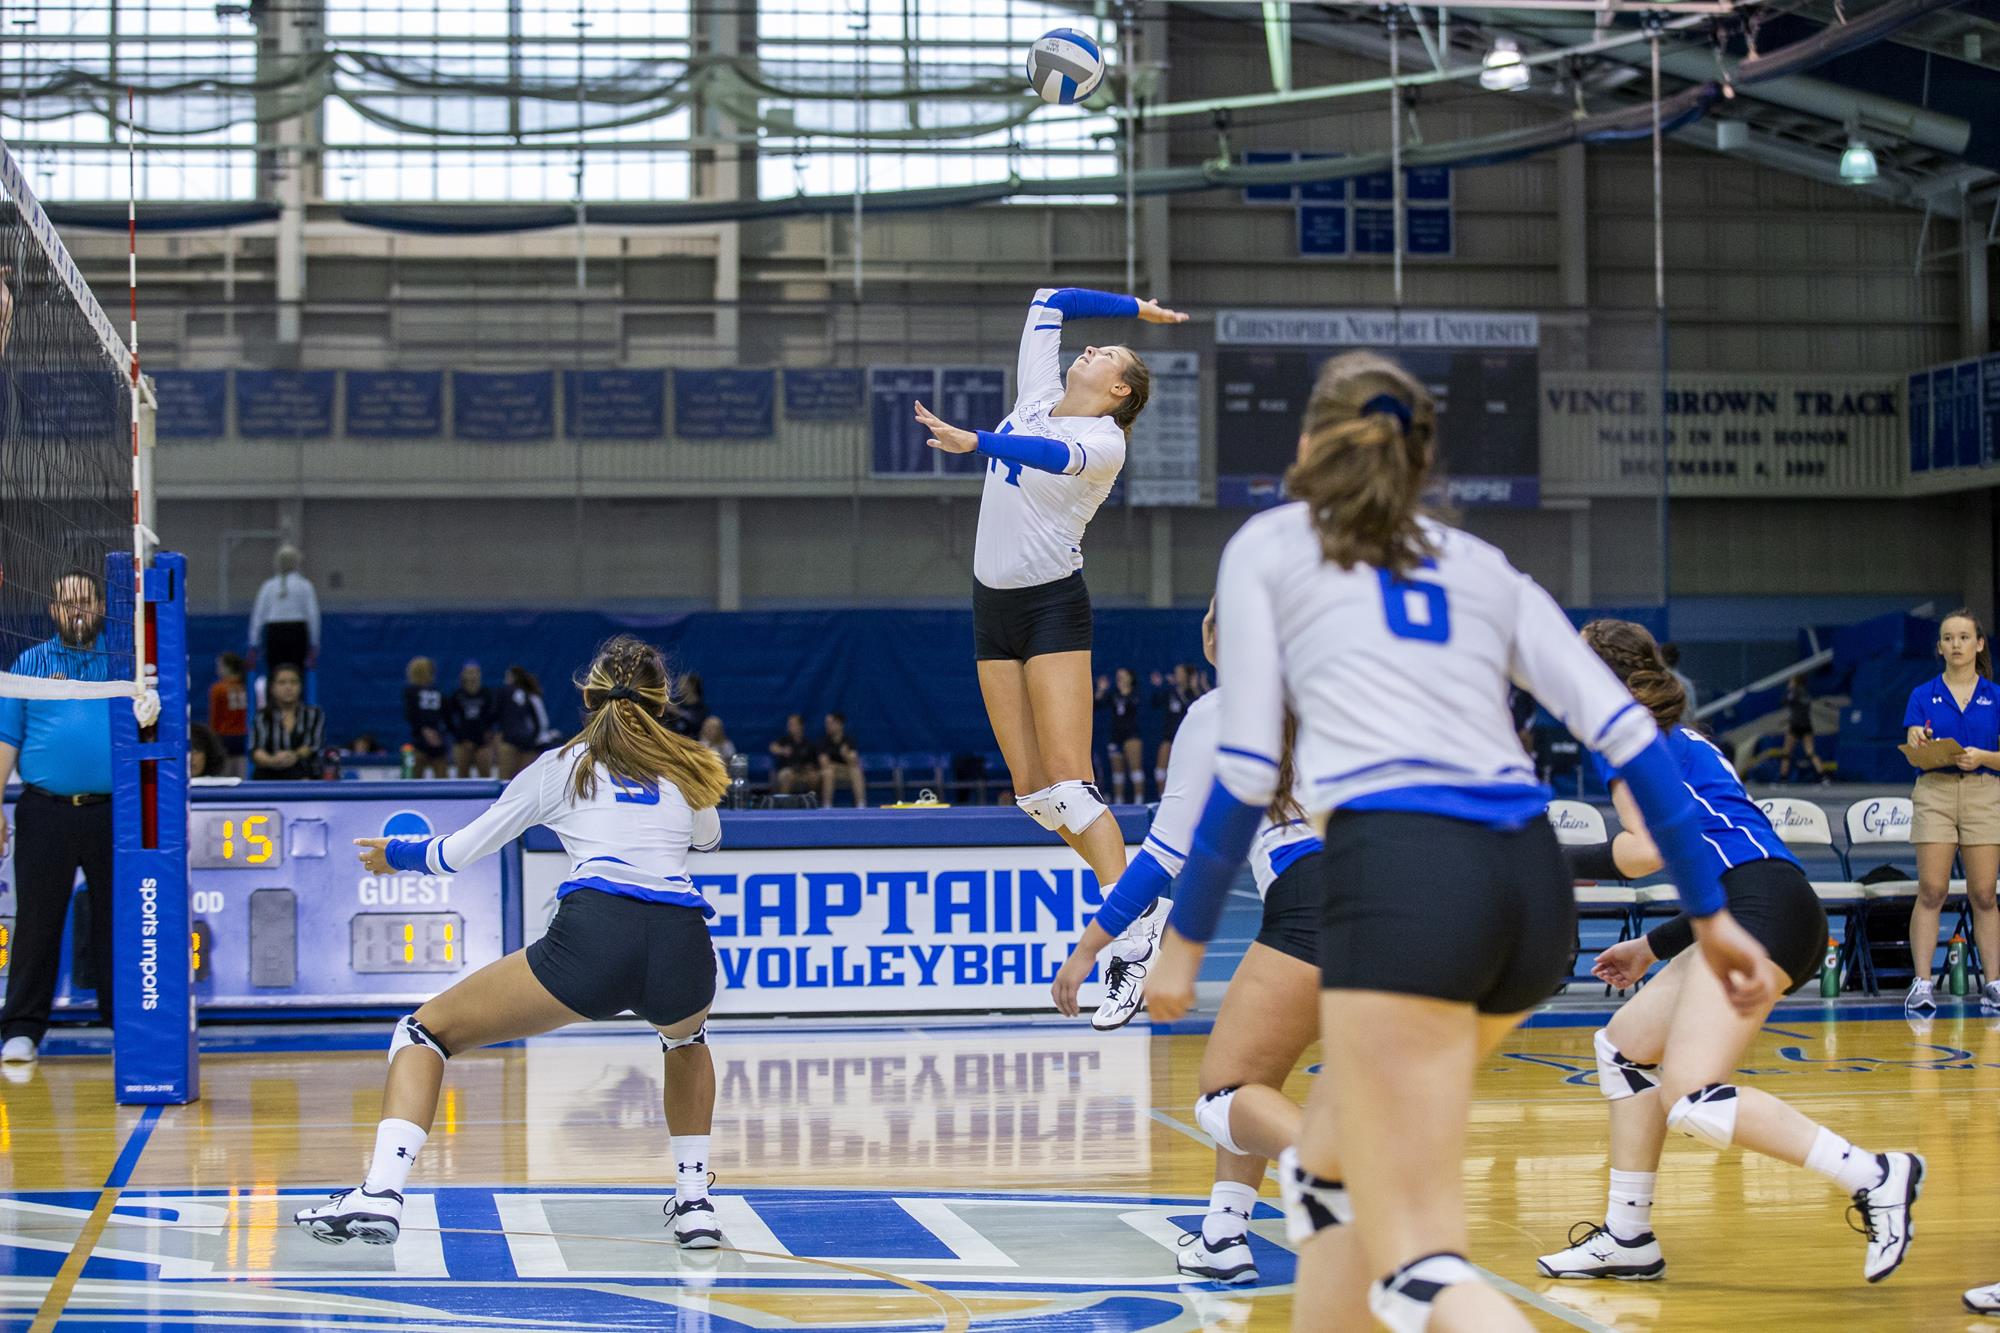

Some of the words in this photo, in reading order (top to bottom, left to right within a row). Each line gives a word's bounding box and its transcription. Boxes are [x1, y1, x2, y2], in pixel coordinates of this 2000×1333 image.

[1221, 313, 1339, 340] CHRISTOPHER
[1346, 315, 1429, 341] NEWPORT
[1435, 316, 1534, 341] UNIVERSITY
[1546, 388, 1648, 417] VINCE
[1664, 389, 1779, 417] BROWN
[1794, 390, 1899, 418] TRACK
[1689, 428, 1712, 446] IN
[1723, 429, 1762, 446] HIS
[1774, 429, 1849, 447] HONOR
[1449, 480, 1512, 502] PEPSI
[1376, 556, 1451, 645] 6
[1863, 802, 1912, 836] Captain
[223, 815, 273, 863] 15
[139, 878, 159, 936] sports
[358, 876, 455, 906] GUEST
[403, 923, 454, 964] 11
[139, 939, 160, 1010] imports
